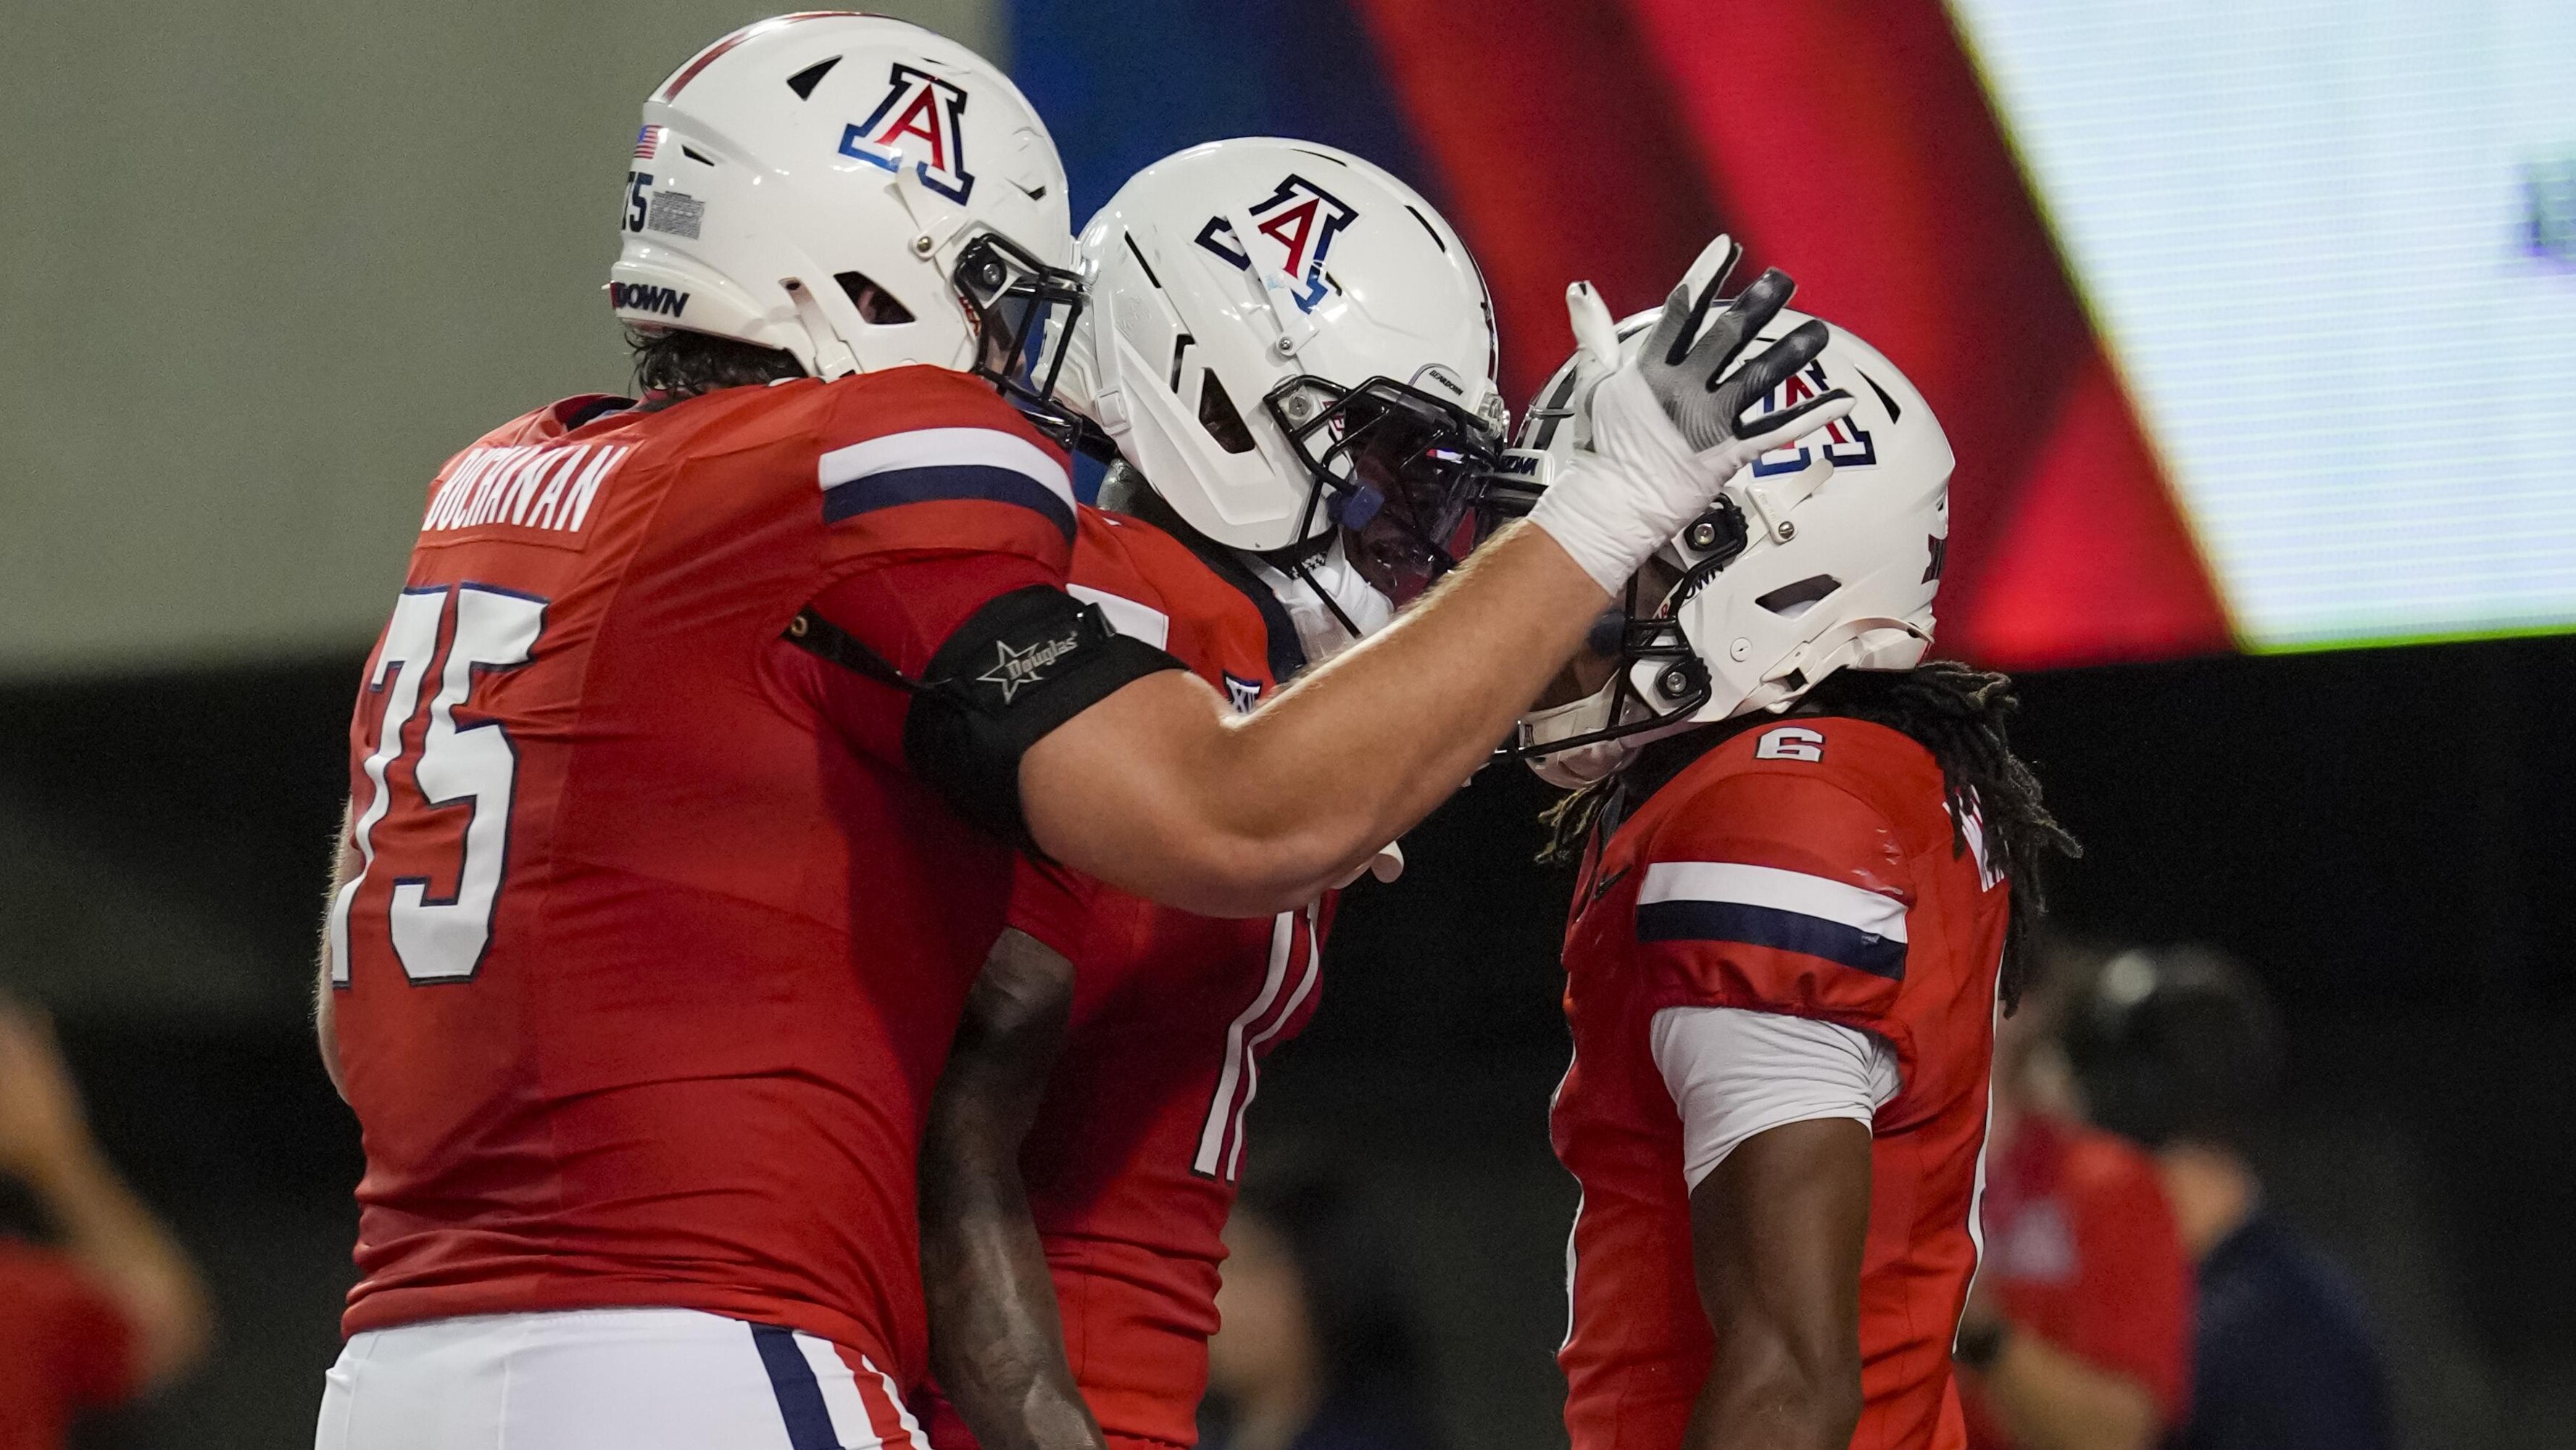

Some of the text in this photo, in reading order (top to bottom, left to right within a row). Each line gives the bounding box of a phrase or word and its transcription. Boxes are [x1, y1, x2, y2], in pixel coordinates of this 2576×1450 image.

[1005, 637, 1078, 681] Douglas
[1754, 726, 1826, 763] 6
[331, 579, 554, 989] 75
